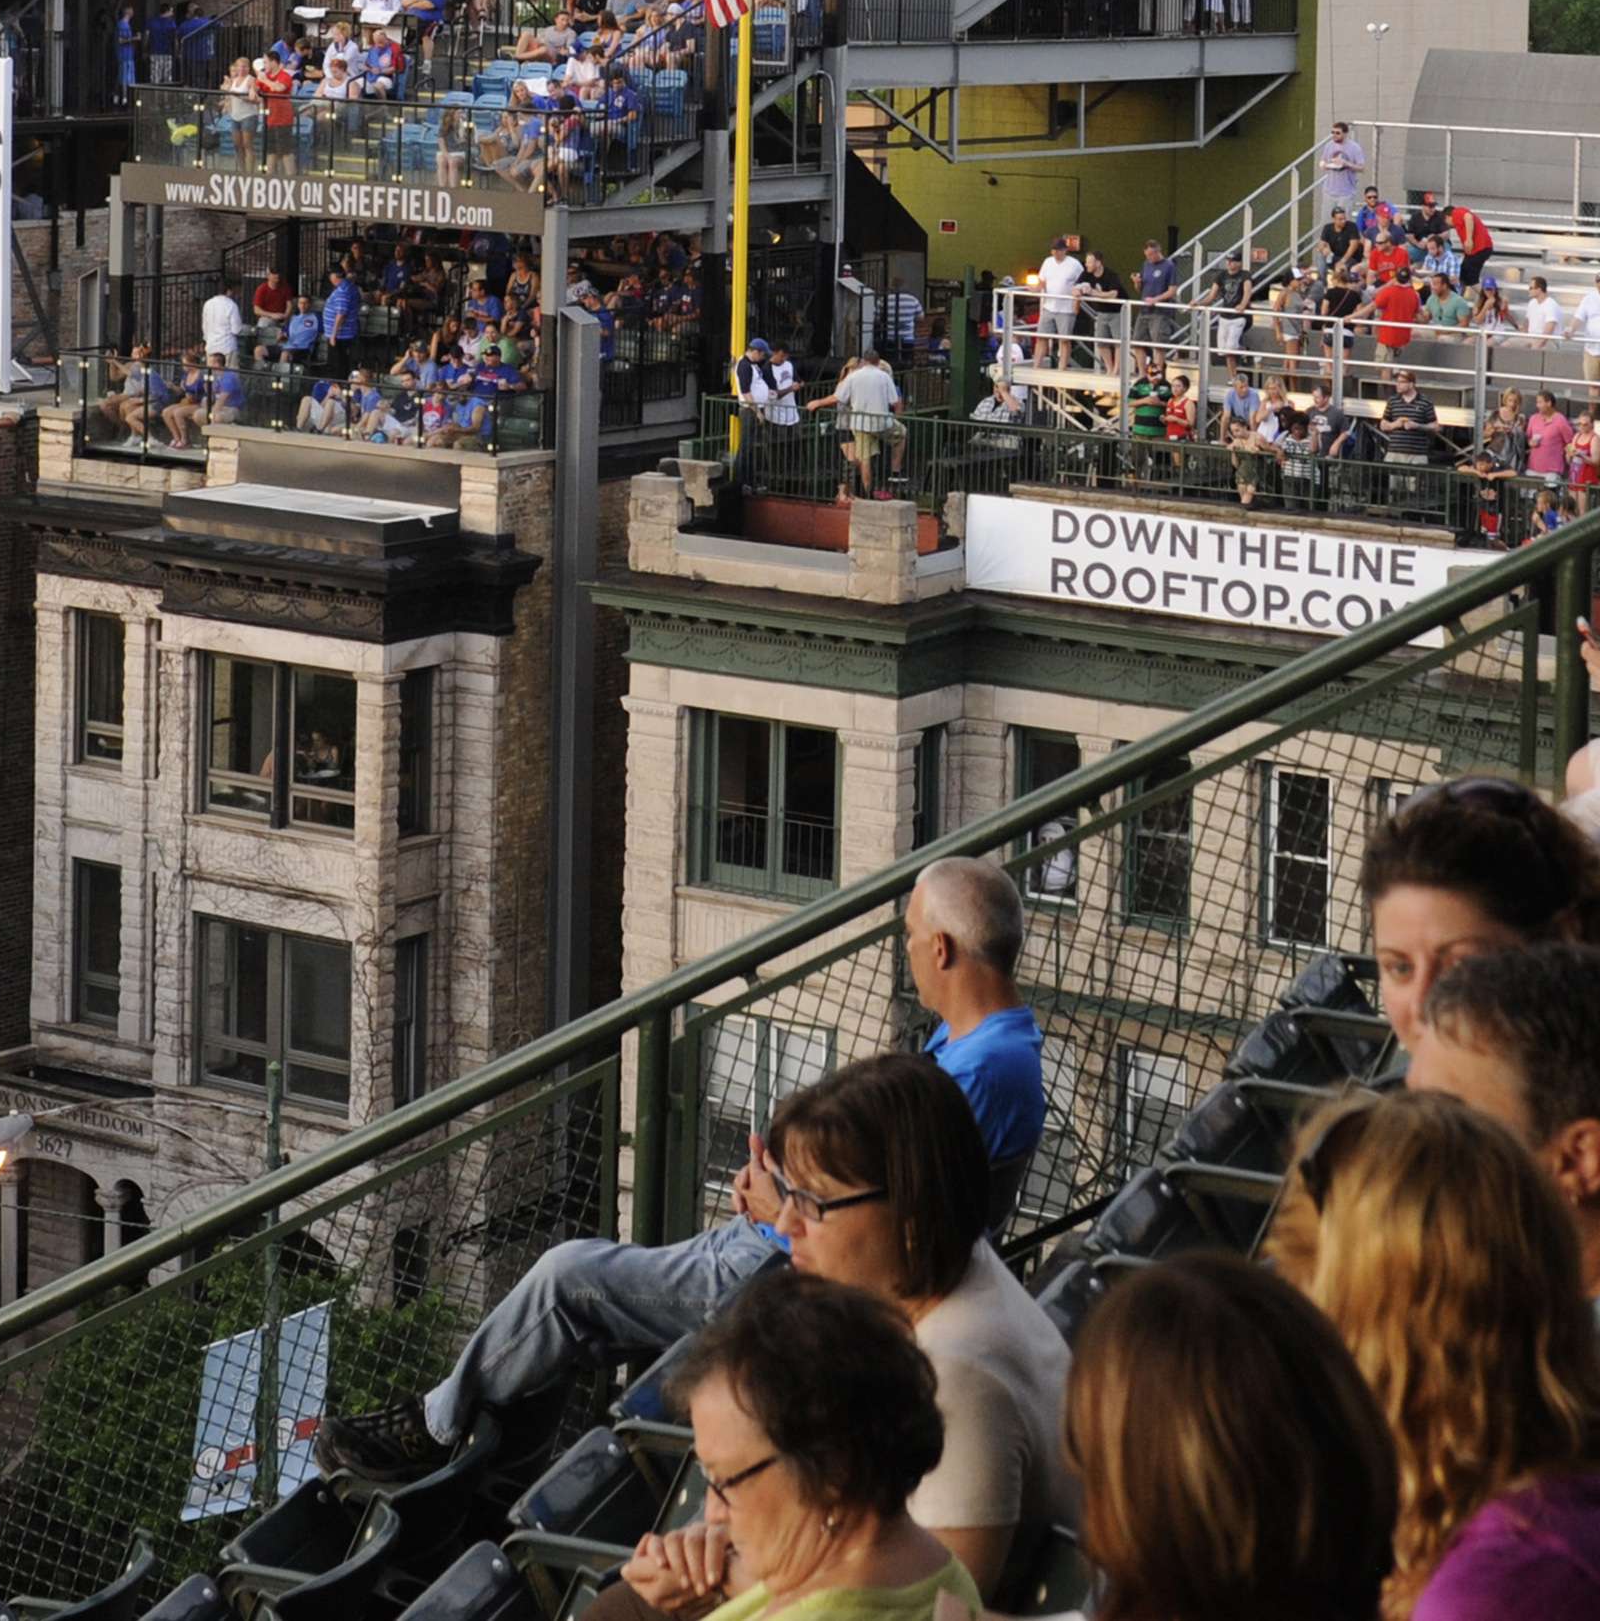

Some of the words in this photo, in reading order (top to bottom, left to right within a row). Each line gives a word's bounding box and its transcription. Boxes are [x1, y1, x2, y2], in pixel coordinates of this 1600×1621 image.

[165, 173, 297, 211] www.SKYBOX
[300, 181, 323, 206] ON
[328, 182, 493, 228] SHEFFIELD.com
[1051, 508, 1199, 561] DOWN
[1208, 528, 1300, 573] THE
[1308, 538, 1417, 587] LINE
[14, 1093, 37, 1112] ON
[36, 1133, 73, 1159] 3627
